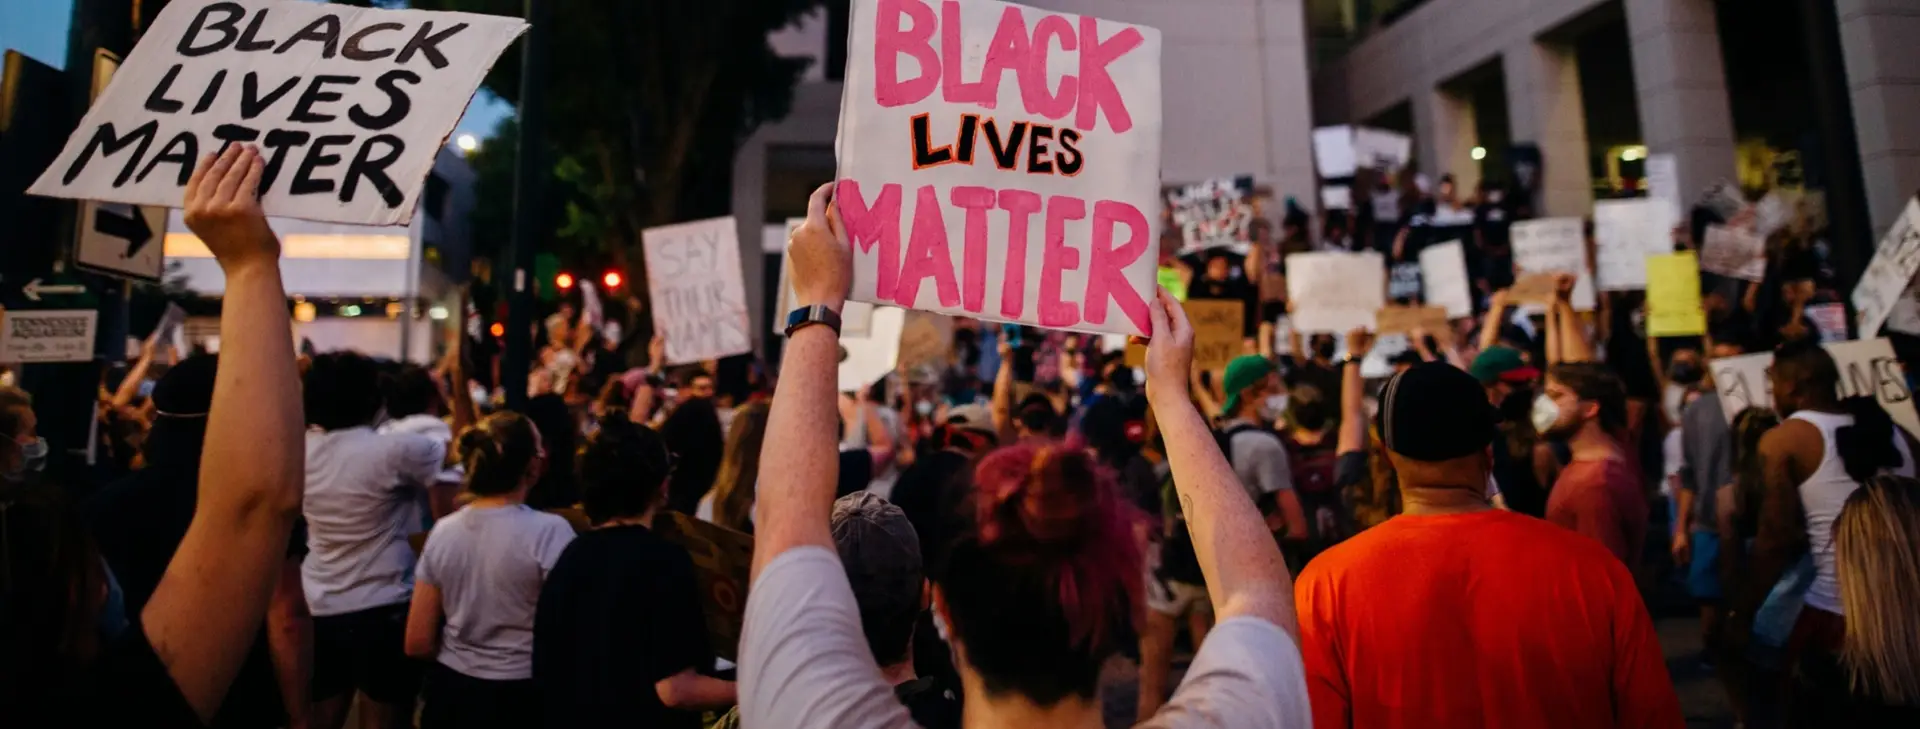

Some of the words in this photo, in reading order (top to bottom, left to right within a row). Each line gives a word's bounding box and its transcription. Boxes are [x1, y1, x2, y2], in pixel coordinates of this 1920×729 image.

[177, 1, 468, 70] BLACK
[874, 0, 1145, 135] BLACK
[144, 64, 421, 130] LIVES
[62, 119, 405, 208] MATTER
[911, 112, 1084, 177] LIVES
[657, 229, 720, 279] SAY
[835, 178, 1152, 337] MATTER
